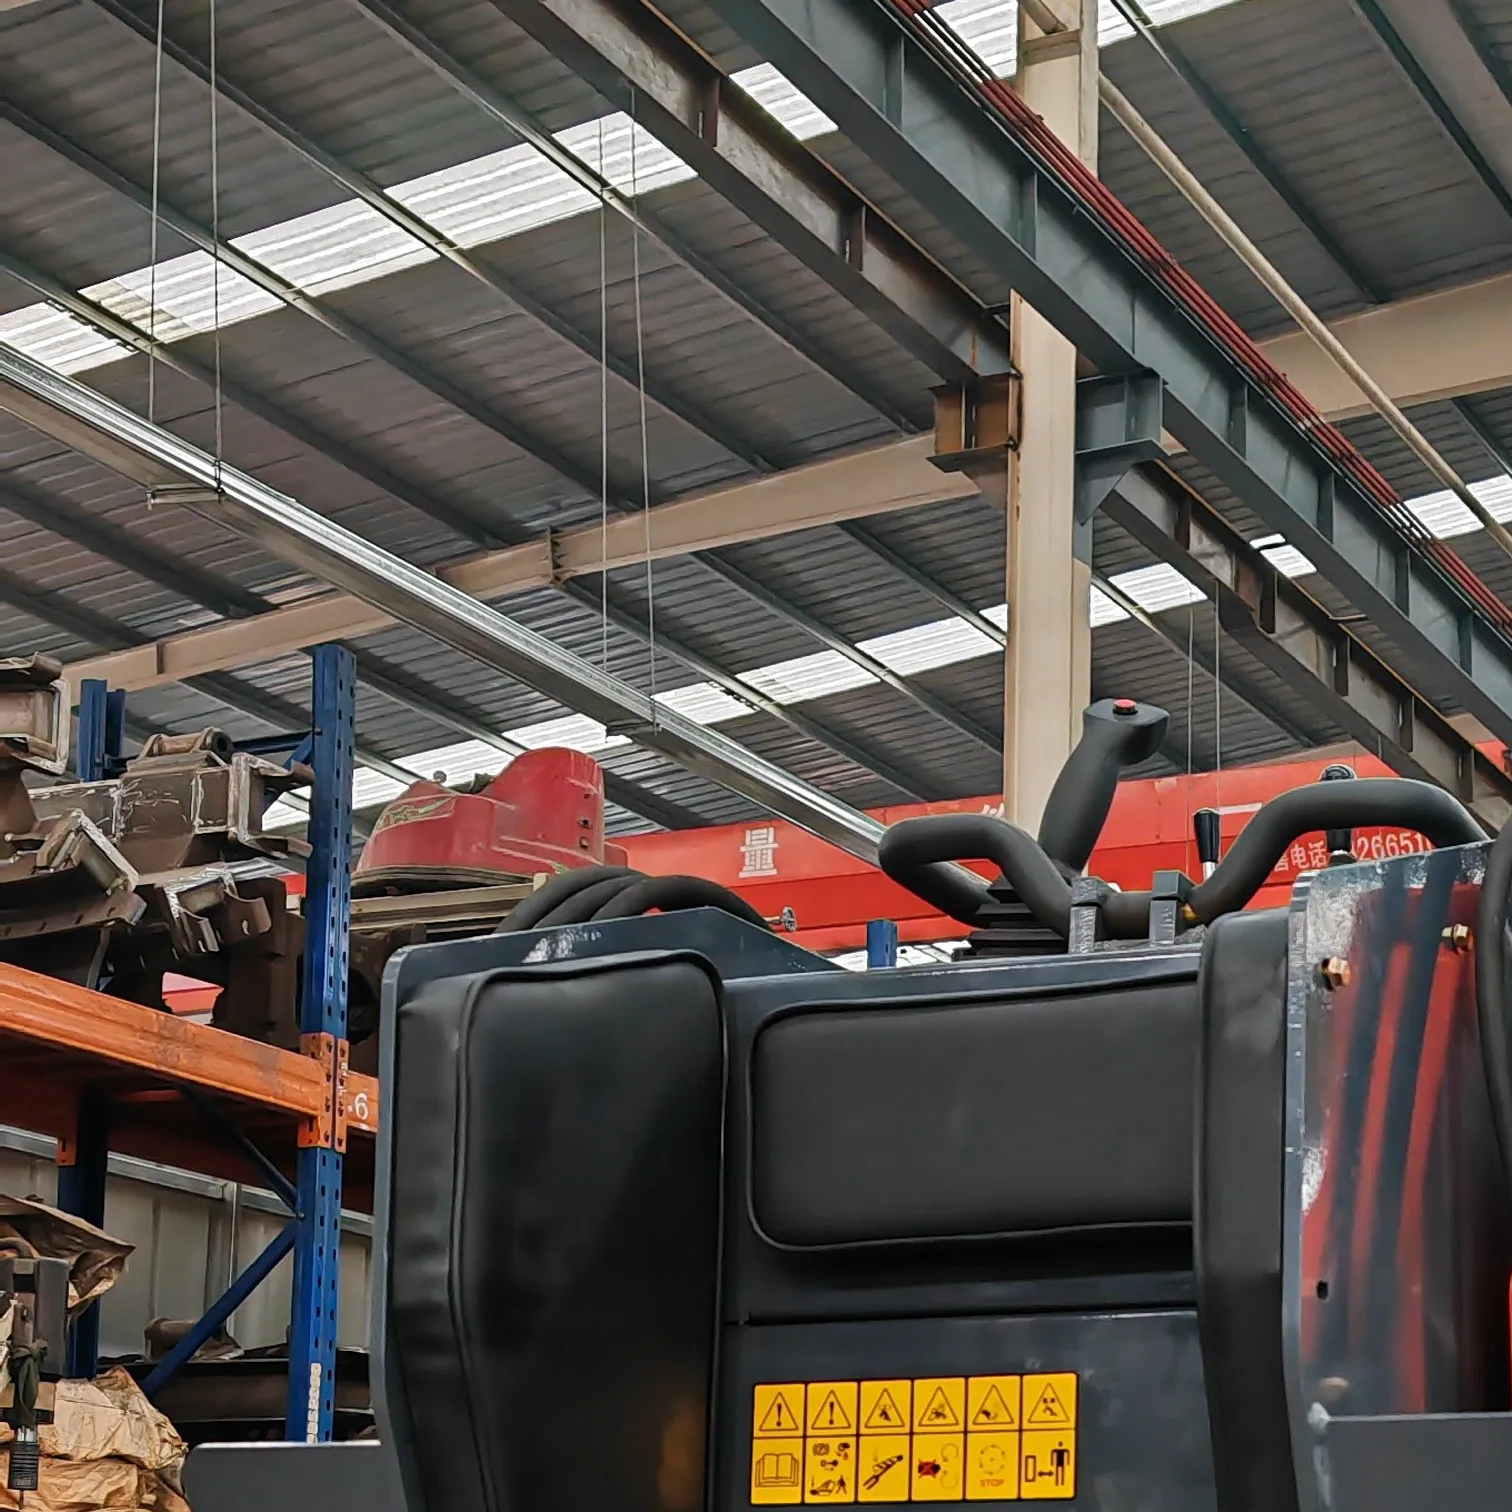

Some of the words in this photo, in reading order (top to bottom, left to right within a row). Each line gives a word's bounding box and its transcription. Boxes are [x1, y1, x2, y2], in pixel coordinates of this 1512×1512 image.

[738, 826, 780, 878] 量
[1351, 832, 1433, 862] 26651
[979, 1478, 1005, 1488] STOP
